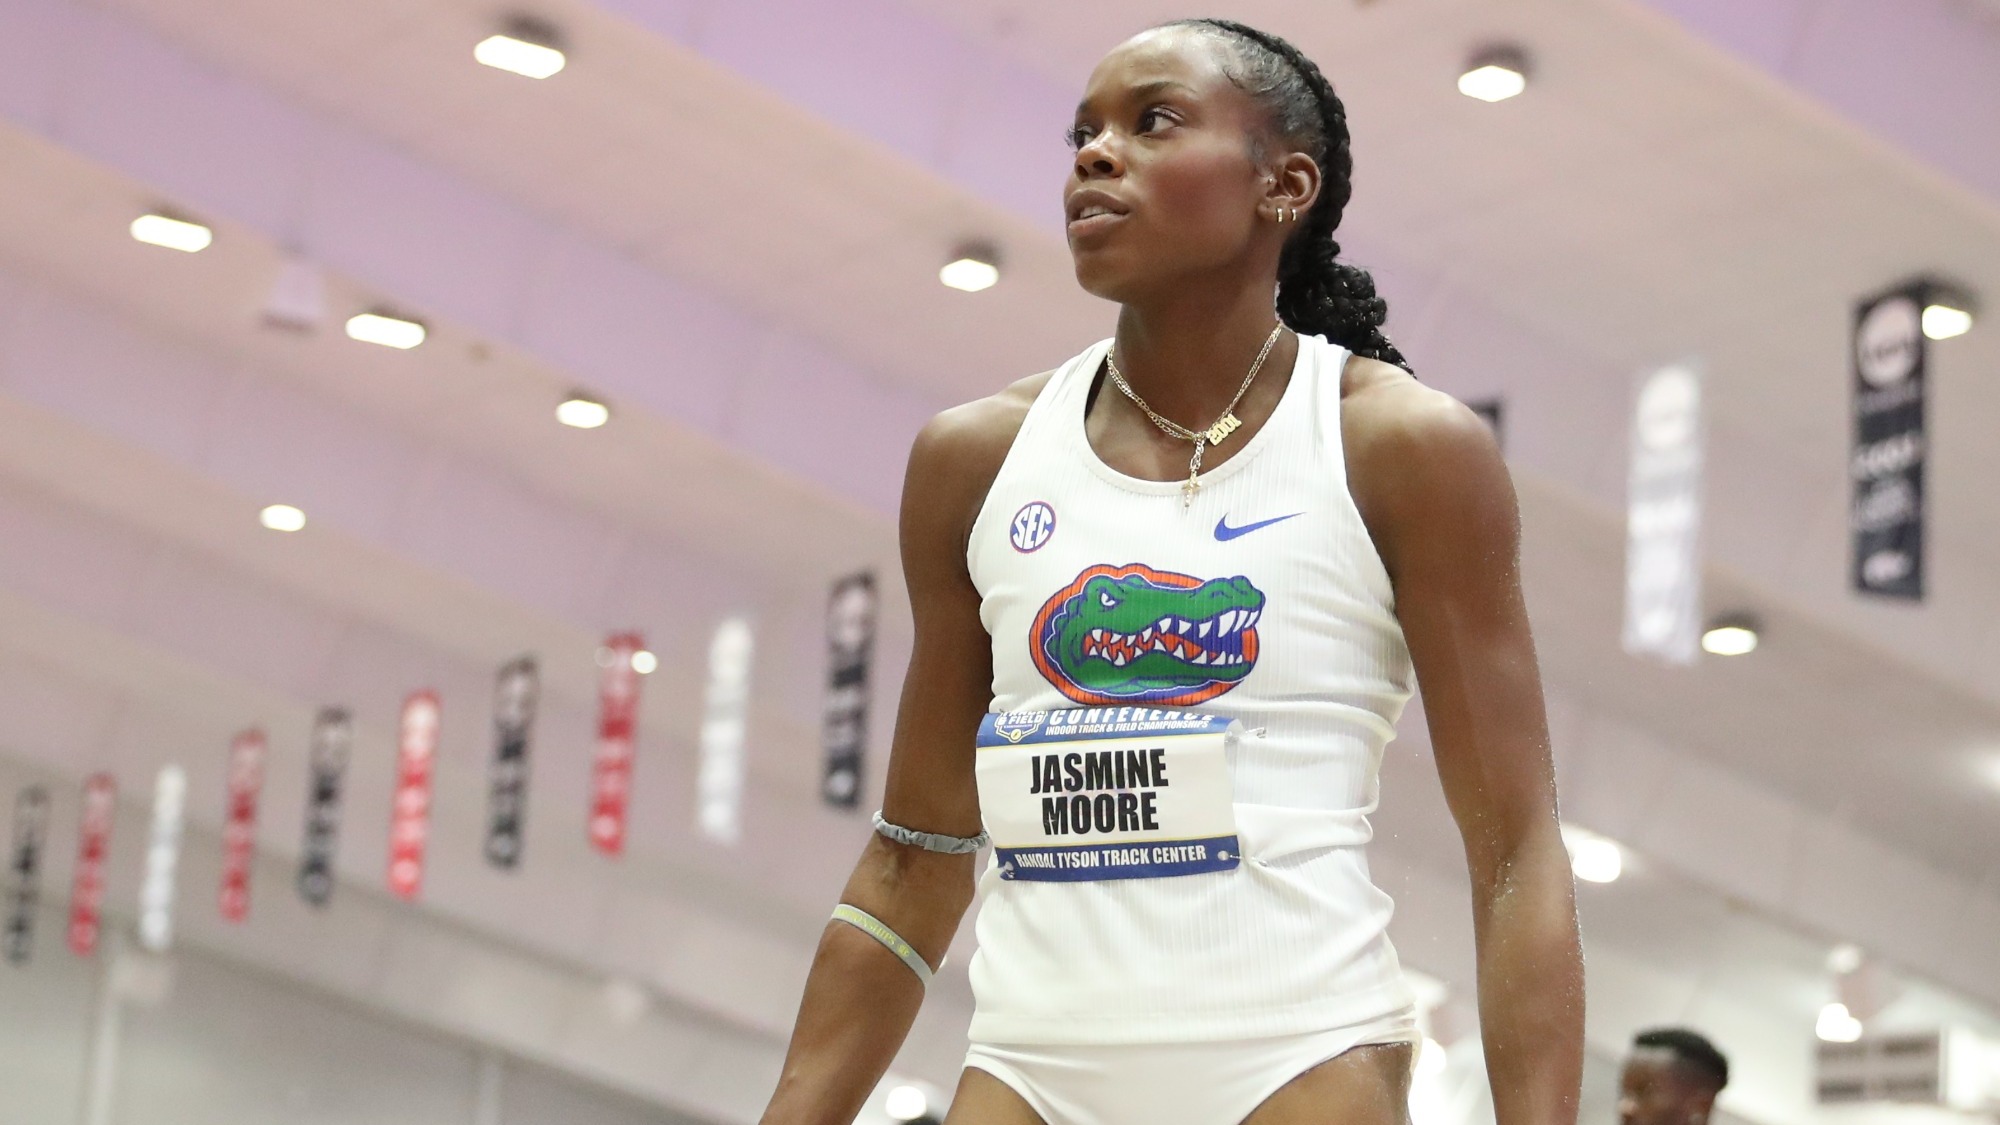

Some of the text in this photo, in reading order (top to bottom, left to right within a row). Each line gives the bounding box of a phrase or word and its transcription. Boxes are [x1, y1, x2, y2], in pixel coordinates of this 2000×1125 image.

[1206, 413, 1242, 446] 2001
[1010, 503, 1054, 551] SEC
[1008, 714, 1044, 725] FIELD
[1045, 725, 1077, 736] INDOOR
[1078, 723, 1106, 734] TRACK
[1106, 724, 1114, 732] &
[1115, 722, 1137, 732] FIELD
[1138, 720, 1210, 731] CHAMPIONSHIPS
[1030, 748, 1169, 794] JASMINE
[1042, 792, 1159, 835] MOORE
[1014, 845, 1207, 869] RANDAL TYSON TRACK CENTER
